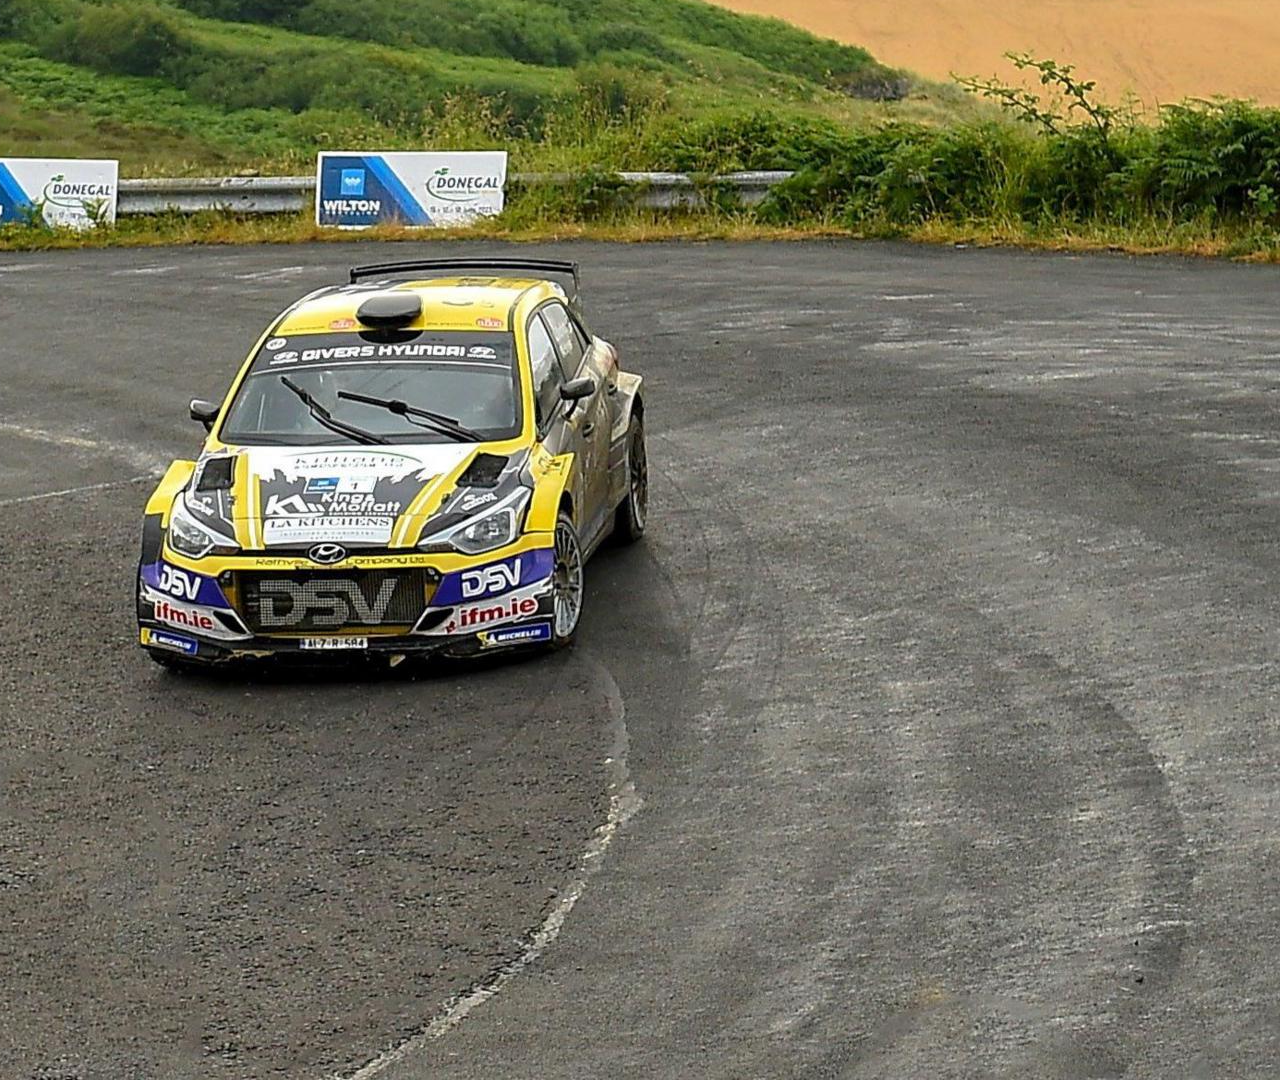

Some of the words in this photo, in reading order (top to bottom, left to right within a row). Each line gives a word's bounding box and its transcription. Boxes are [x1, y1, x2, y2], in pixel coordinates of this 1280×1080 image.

[437, 176, 499, 188] DONEGAL
[52, 184, 111, 196] DONEGAL
[323, 200, 380, 212] WILTON
[301, 346, 375, 361] DIVERS
[378, 344, 466, 358] HYUNDAI
[321, 493, 364, 504] King
[328, 501, 400, 512] Moffatt
[298, 517, 390, 528] KITCHENS
[159, 564, 202, 600] DSV
[461, 558, 521, 598] DSV
[260, 578, 398, 626] DSV
[155, 600, 213, 630] ifm.ie
[461, 597, 537, 626] ifm.ie
